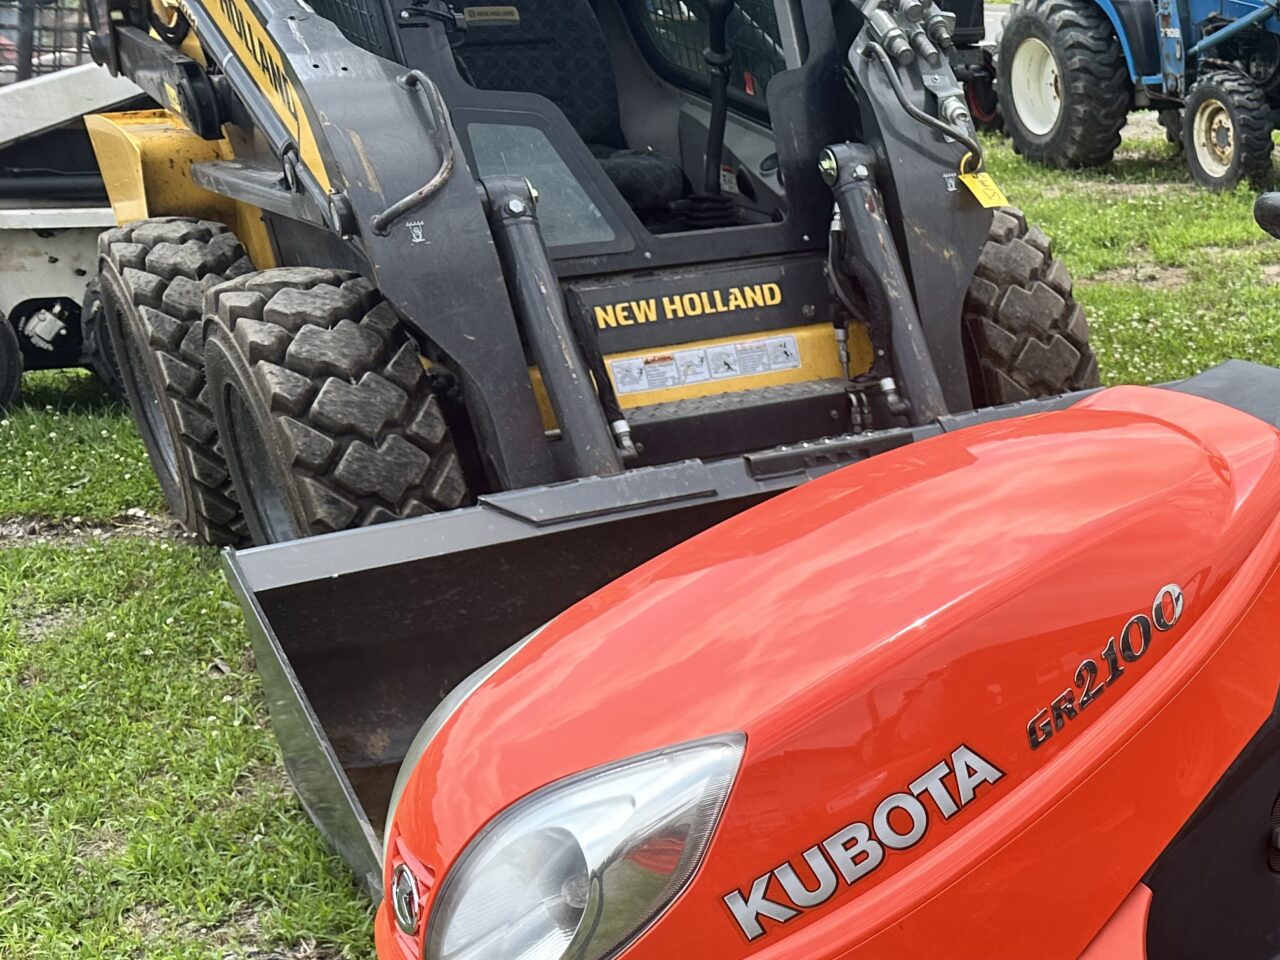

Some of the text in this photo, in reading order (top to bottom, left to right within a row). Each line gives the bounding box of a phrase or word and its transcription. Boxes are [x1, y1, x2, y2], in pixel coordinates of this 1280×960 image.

[594, 282, 783, 329] NEW HOLLAND
[1026, 582, 1184, 752] GR2100
[722, 744, 1006, 943] KUBOTA
